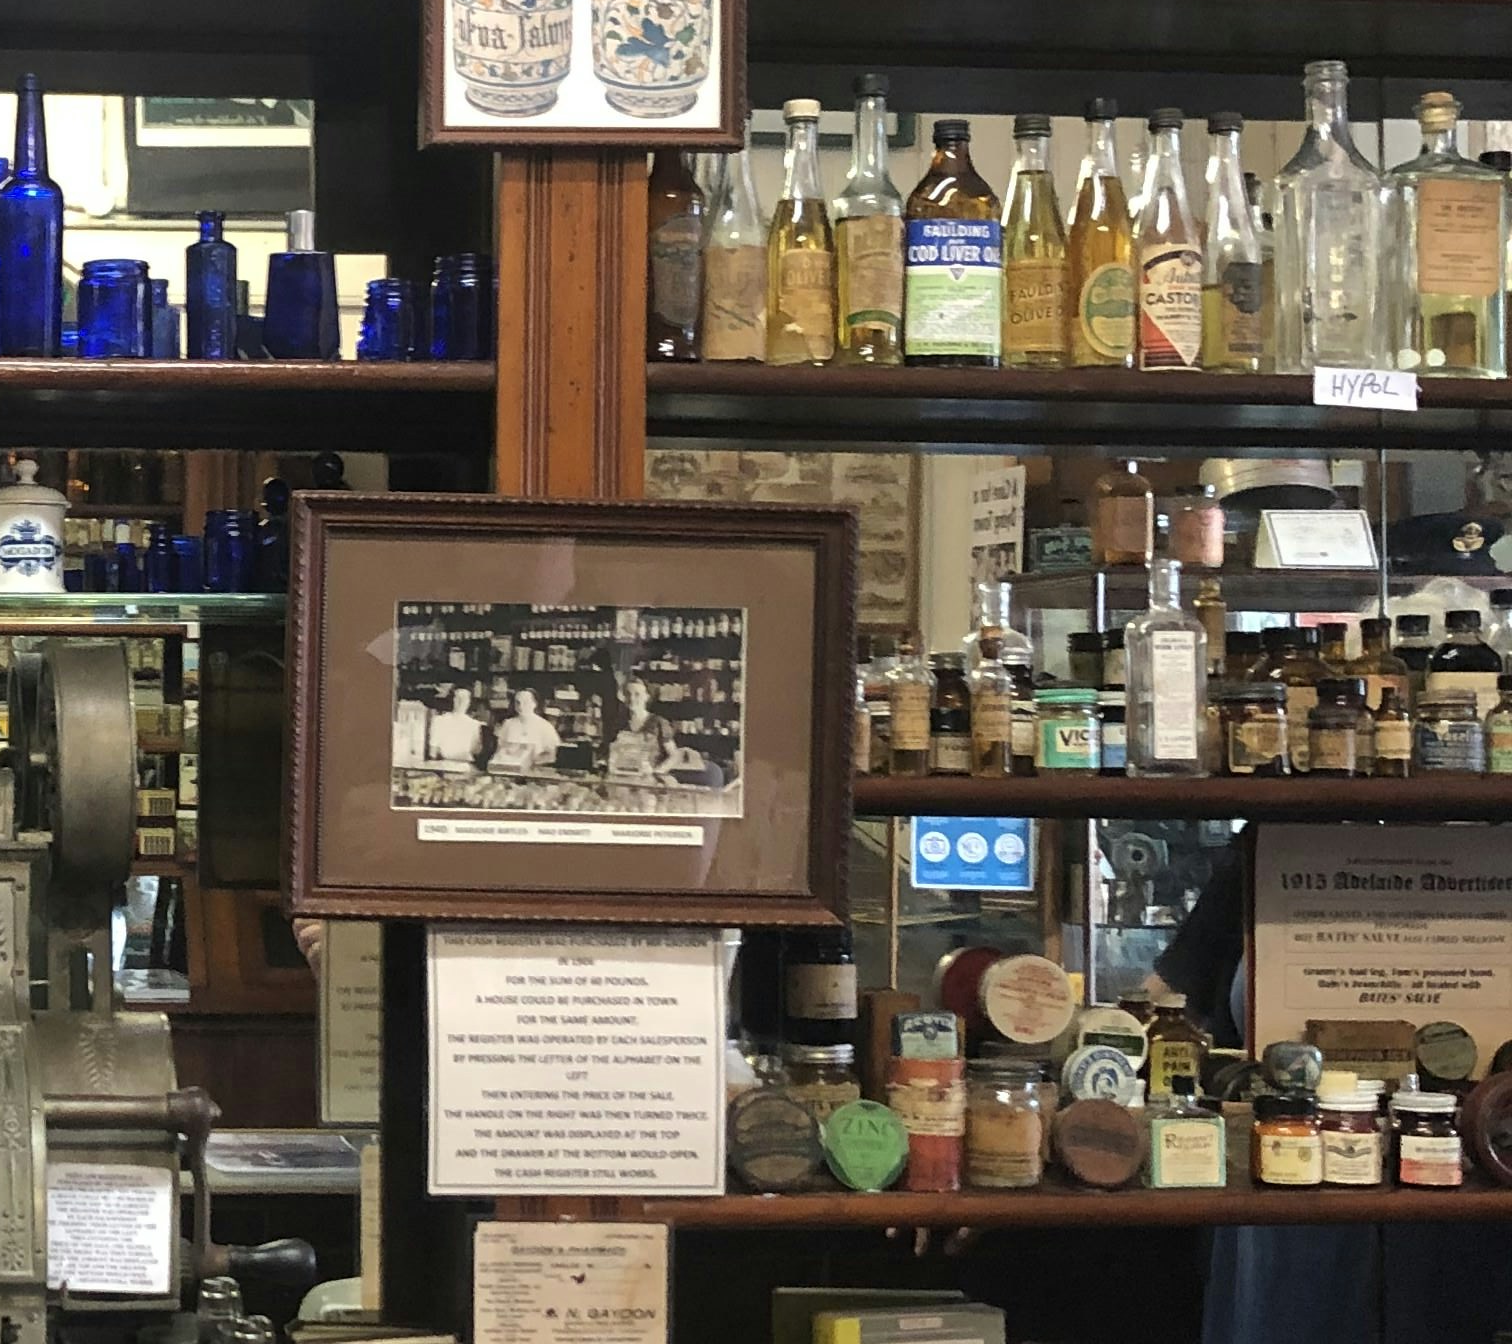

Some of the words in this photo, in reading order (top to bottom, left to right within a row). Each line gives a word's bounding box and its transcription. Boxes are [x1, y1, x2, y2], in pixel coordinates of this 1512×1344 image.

[923, 225, 990, 238] FAULDING
[908, 245, 938, 262] COD
[941, 246, 980, 262] LIVER
[1333, 871, 1413, 890] Adelaide
